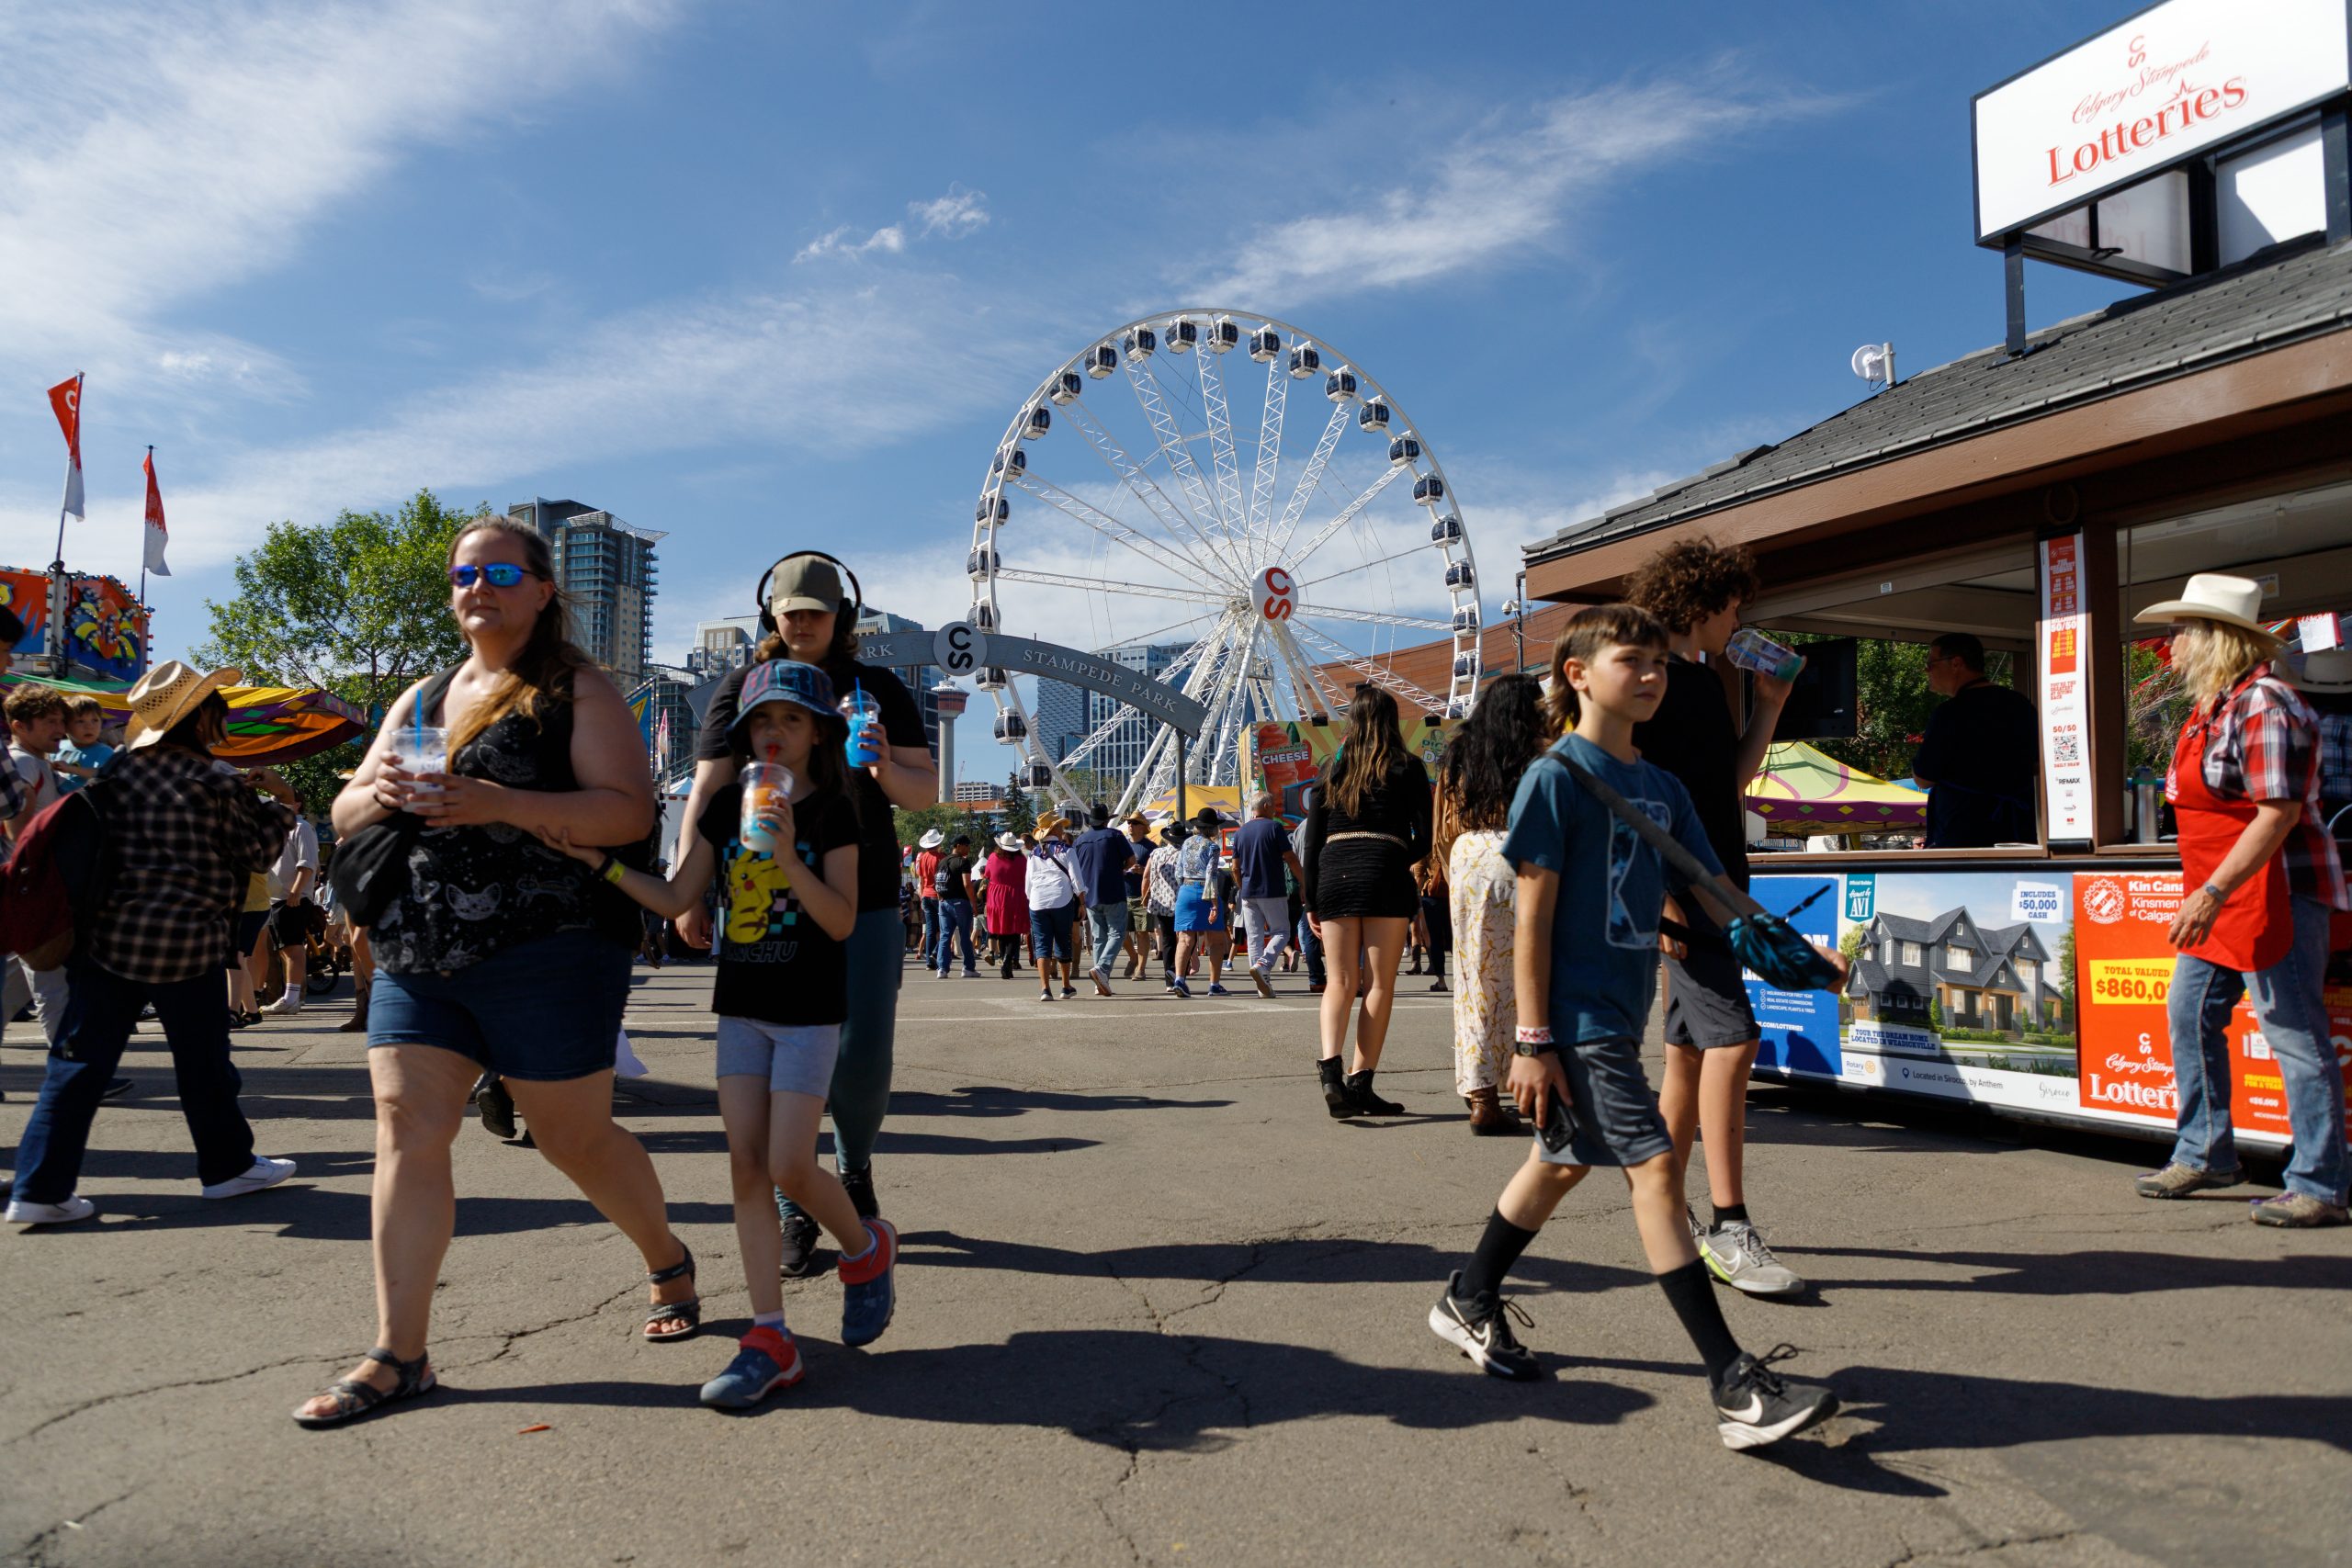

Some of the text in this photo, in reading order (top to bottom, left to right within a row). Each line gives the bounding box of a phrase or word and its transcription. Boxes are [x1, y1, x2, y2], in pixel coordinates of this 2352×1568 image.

[2072, 40, 2211, 125] Calgary Stampede
[2046, 75, 2250, 187] Lotteries
[1263, 567, 1292, 621] CS
[947, 625, 975, 671] CS
[1023, 649, 1179, 714] STAMPEDE PARK
[2052, 724, 2077, 734] 50/50
[1261, 750, 1309, 765] CHEESE
[2129, 881, 2183, 893] Kin Cana
[1849, 897, 1869, 917] AVI
[2018, 899, 2058, 911] $50,000
[2132, 897, 2179, 908] Kinsmen
[2028, 911, 2048, 919] CASH
[2138, 908, 2177, 924] Calgar
[2104, 965, 2170, 977] TOTAL VALUED
[2096, 978, 2171, 1001] $860,0
[1850, 1035, 1879, 1044] LOCATED
[1880, 1037, 1886, 1045] IN
[1855, 1028, 1928, 1042] TOUR THE DREAM HOME
[1846, 1060, 1864, 1070] Rotary
[2106, 1053, 2176, 1077] Calgary Stamp
[1912, 1071, 2004, 1089] Located in Sirocco, by Anthem
[2088, 1073, 2179, 1111] Lotteri
